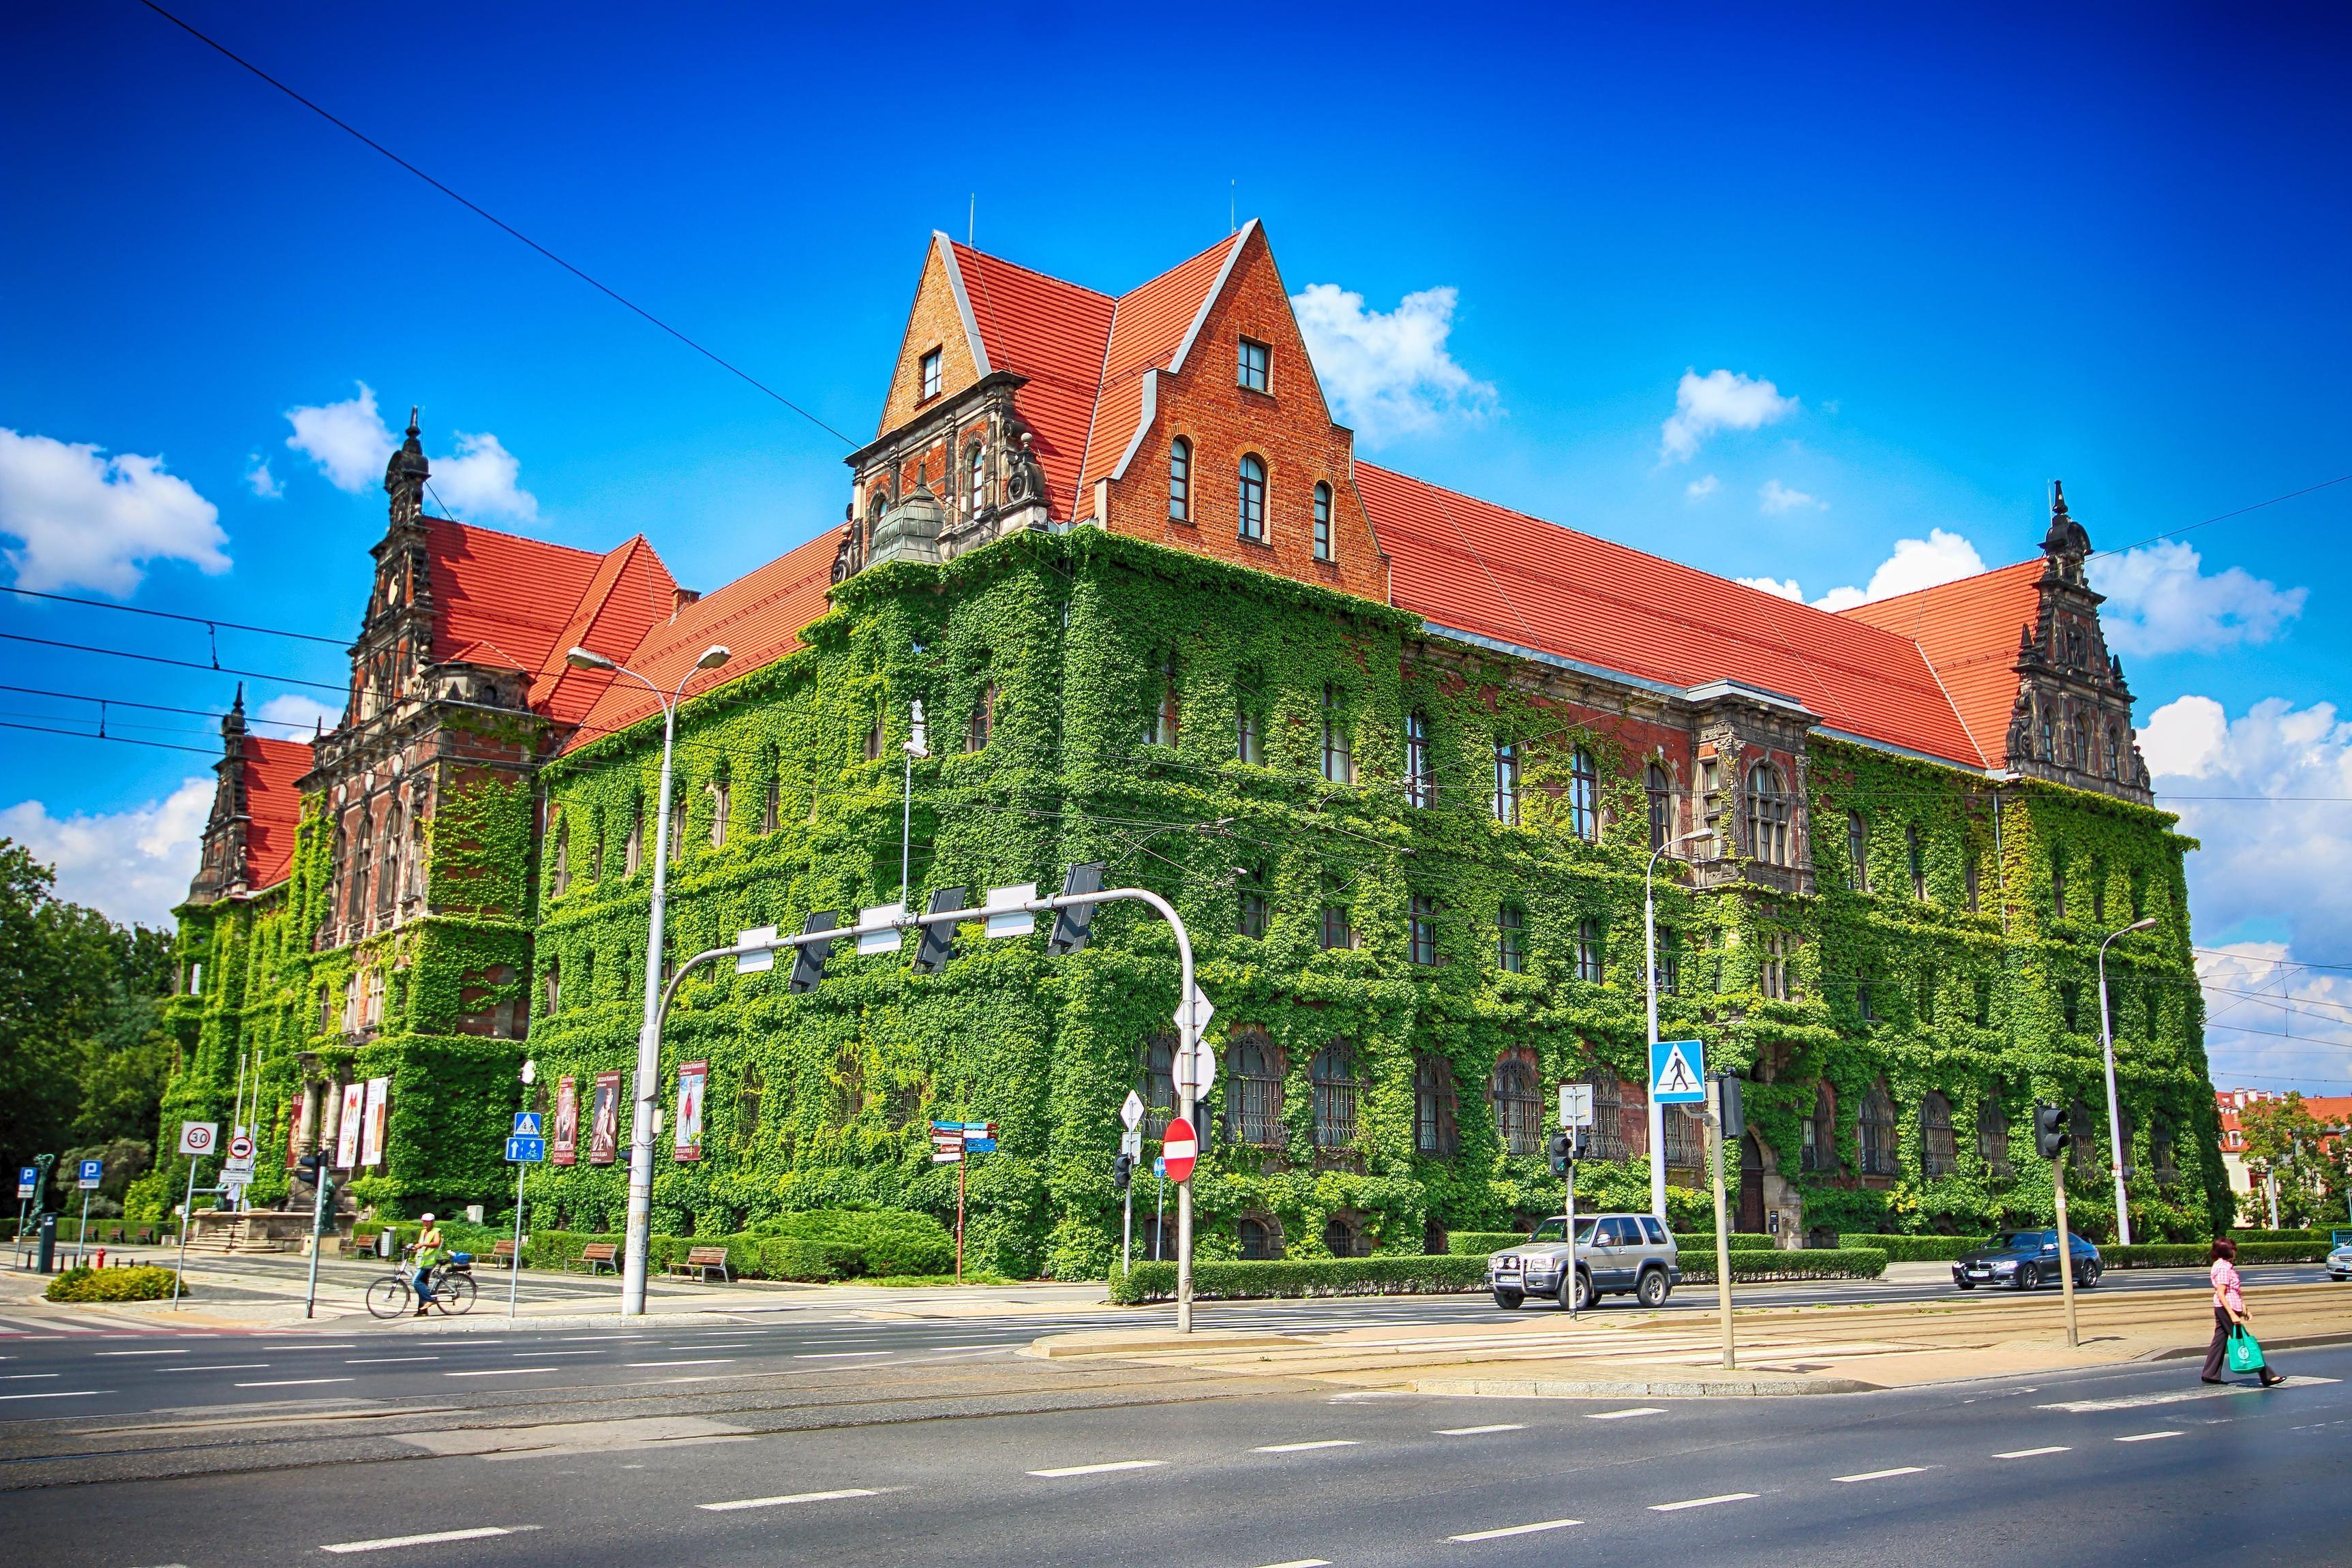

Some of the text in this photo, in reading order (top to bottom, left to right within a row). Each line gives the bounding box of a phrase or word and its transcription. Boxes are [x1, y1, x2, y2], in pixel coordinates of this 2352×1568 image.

[191, 1133, 207, 1143] 30
[23, 1169, 33, 1180] P
[85, 1162, 97, 1177] P
